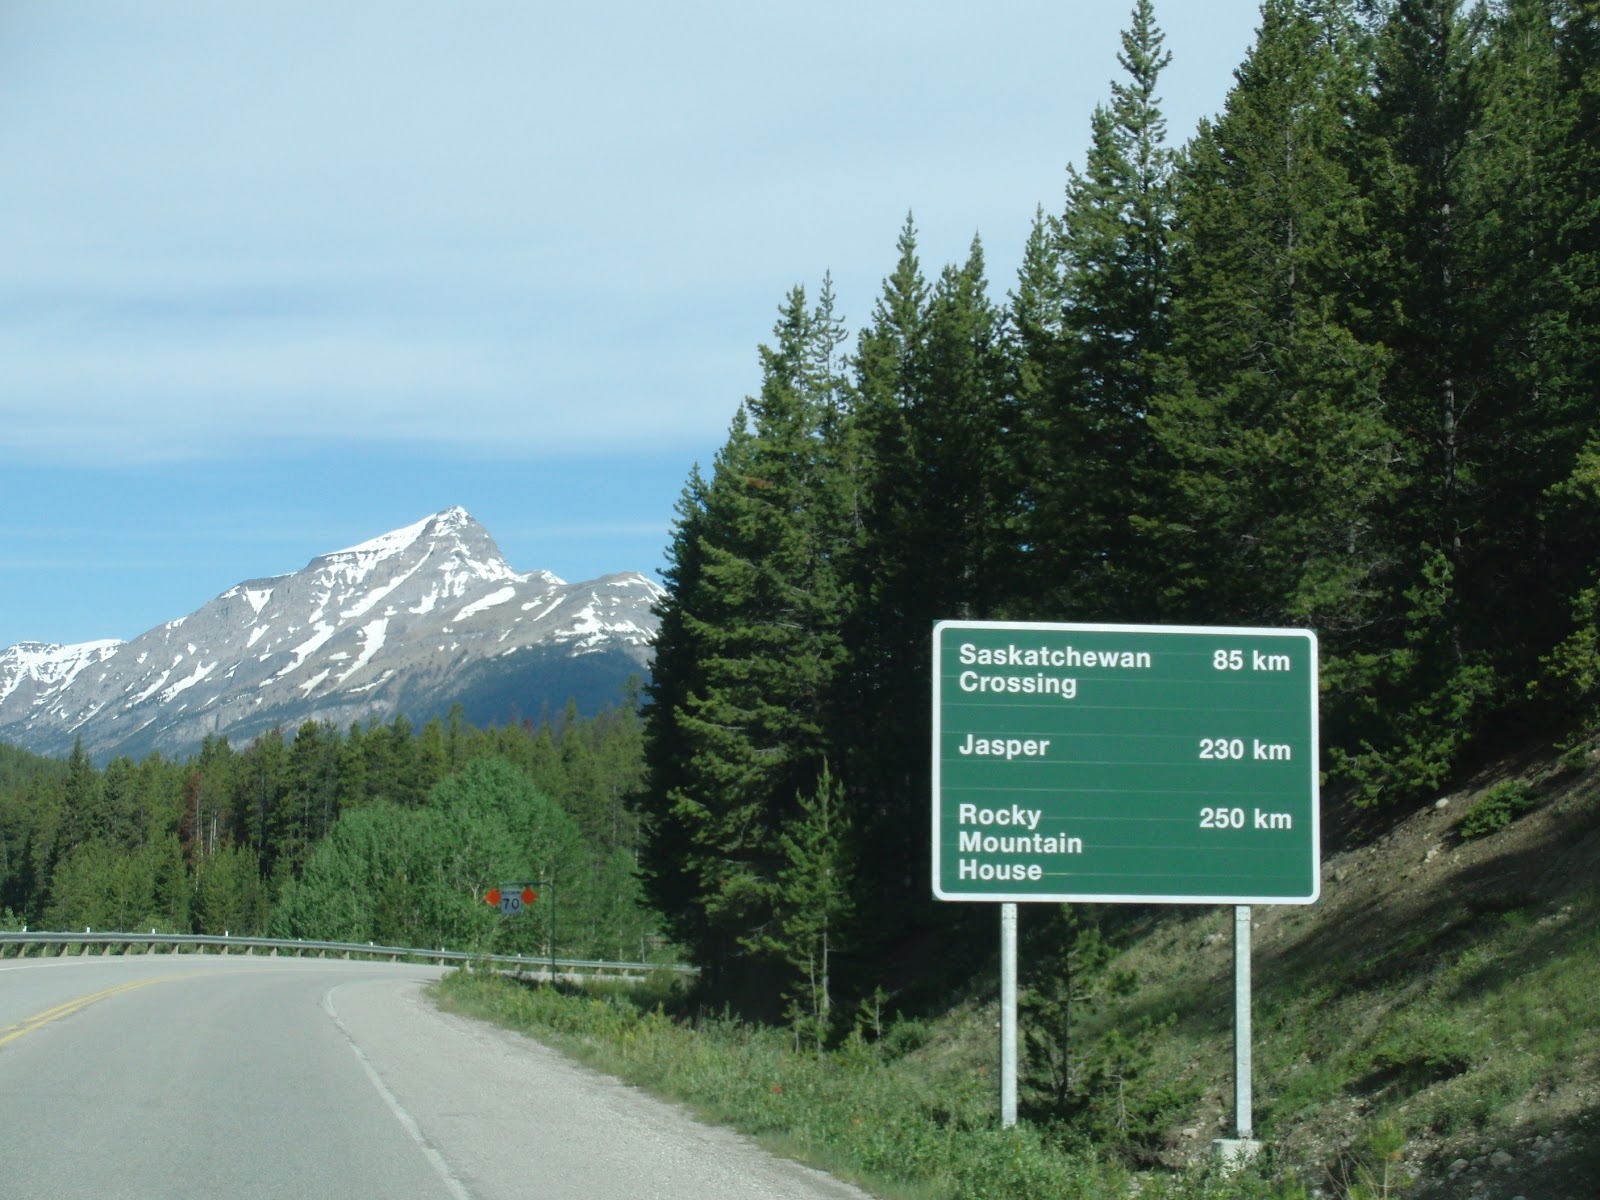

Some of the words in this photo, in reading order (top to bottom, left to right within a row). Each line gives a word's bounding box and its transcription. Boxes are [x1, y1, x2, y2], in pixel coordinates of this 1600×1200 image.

[960, 643, 1151, 668] Saskatchewan
[1213, 650, 1243, 670] 85
[1253, 650, 1290, 671] km
[960, 671, 1076, 699] Crossing
[959, 734, 1050, 760] Jasper
[1199, 738, 1244, 759] 230
[1254, 739, 1291, 760] km
[959, 804, 1041, 830] Rocky
[1200, 807, 1245, 828] 250
[1254, 808, 1292, 829] km
[959, 831, 1082, 853] Mountain
[959, 859, 1042, 880] House
[503, 898, 519, 910] 70
